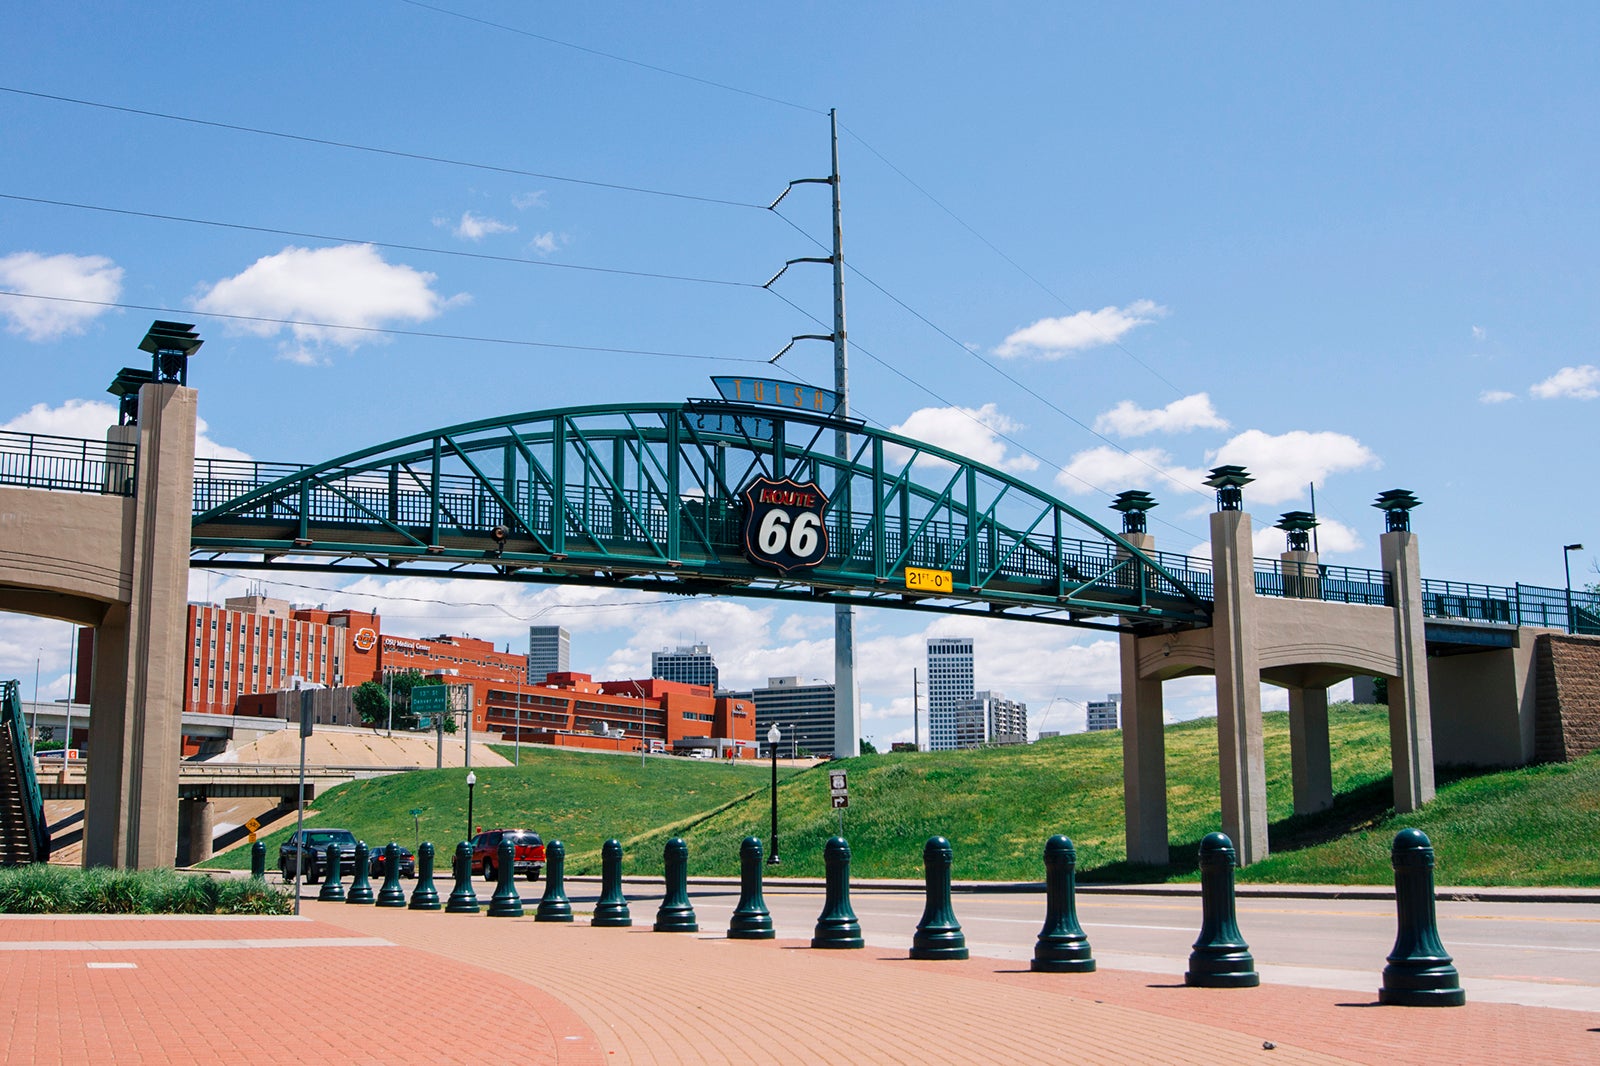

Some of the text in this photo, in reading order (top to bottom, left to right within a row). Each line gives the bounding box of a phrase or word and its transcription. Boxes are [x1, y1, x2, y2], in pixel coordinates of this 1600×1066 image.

[733, 379, 823, 411] TULSA
[759, 488, 817, 508] ROUTE
[758, 508, 822, 558] 66
[397, 640, 415, 649] Medical
[415, 642, 431, 651] Center
